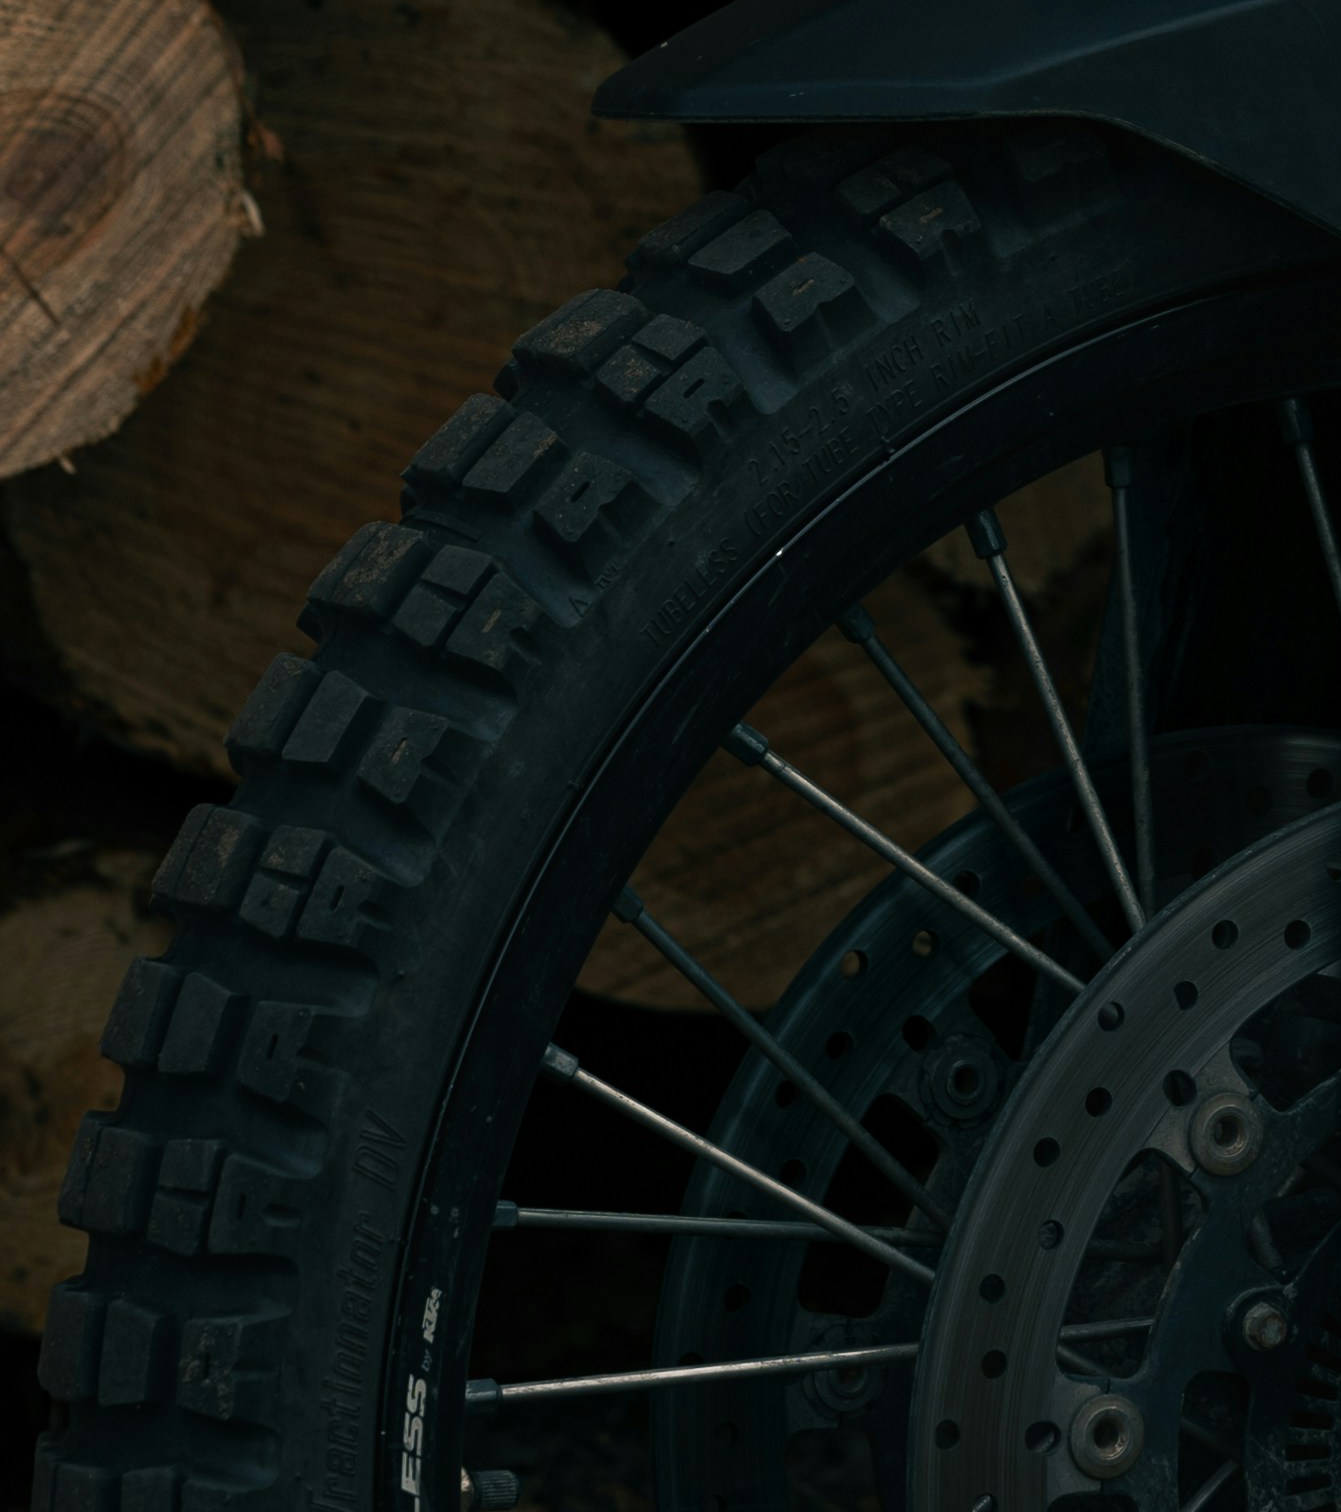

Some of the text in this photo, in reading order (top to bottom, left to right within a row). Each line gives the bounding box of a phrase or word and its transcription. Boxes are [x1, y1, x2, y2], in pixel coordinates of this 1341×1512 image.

[864, 335, 924, 391] INCH
[931, 298, 982, 348] RIM
[640, 536, 738, 648] TUBELESS
[802, 425, 860, 485] TUBE
[864, 378, 923, 435] TYPE
[401, 1373, 428, 1512] ESS
